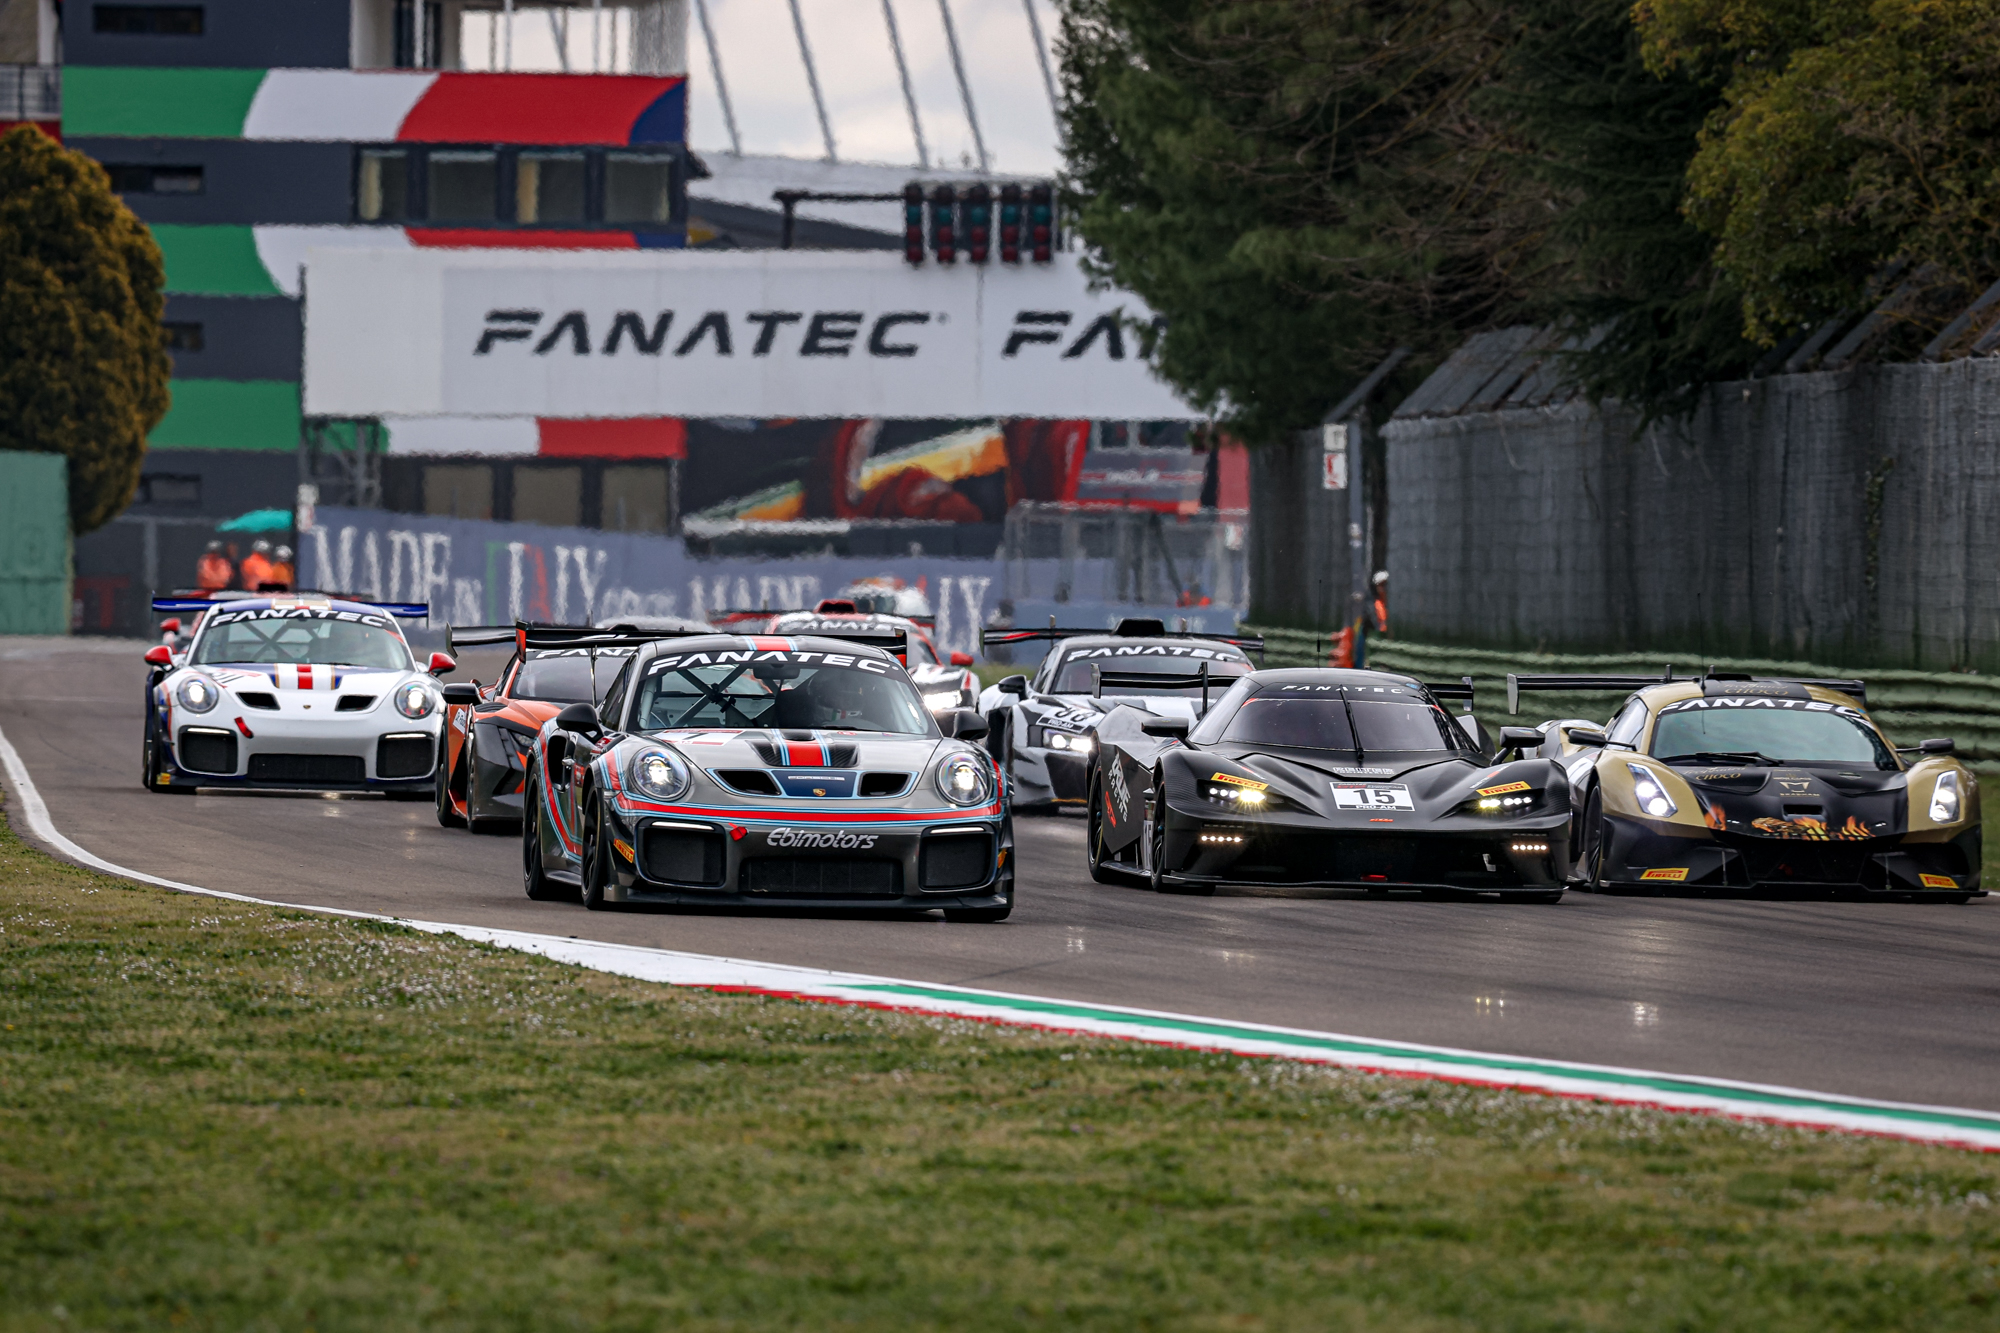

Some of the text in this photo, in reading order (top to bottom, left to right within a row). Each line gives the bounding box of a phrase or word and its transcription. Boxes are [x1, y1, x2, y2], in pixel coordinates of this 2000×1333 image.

[474, 308, 932, 356] FANATEC
[210, 609, 388, 628] FANATEC
[647, 650, 894, 676] FANATEC
[1066, 646, 1241, 662] FANATEC
[1281, 685, 1405, 694] FANATEC
[1657, 698, 1862, 718] FANATEC
[1353, 789, 1396, 805] 15
[766, 827, 880, 849] Ebimotors
[1645, 870, 1684, 879] PIRELLI
